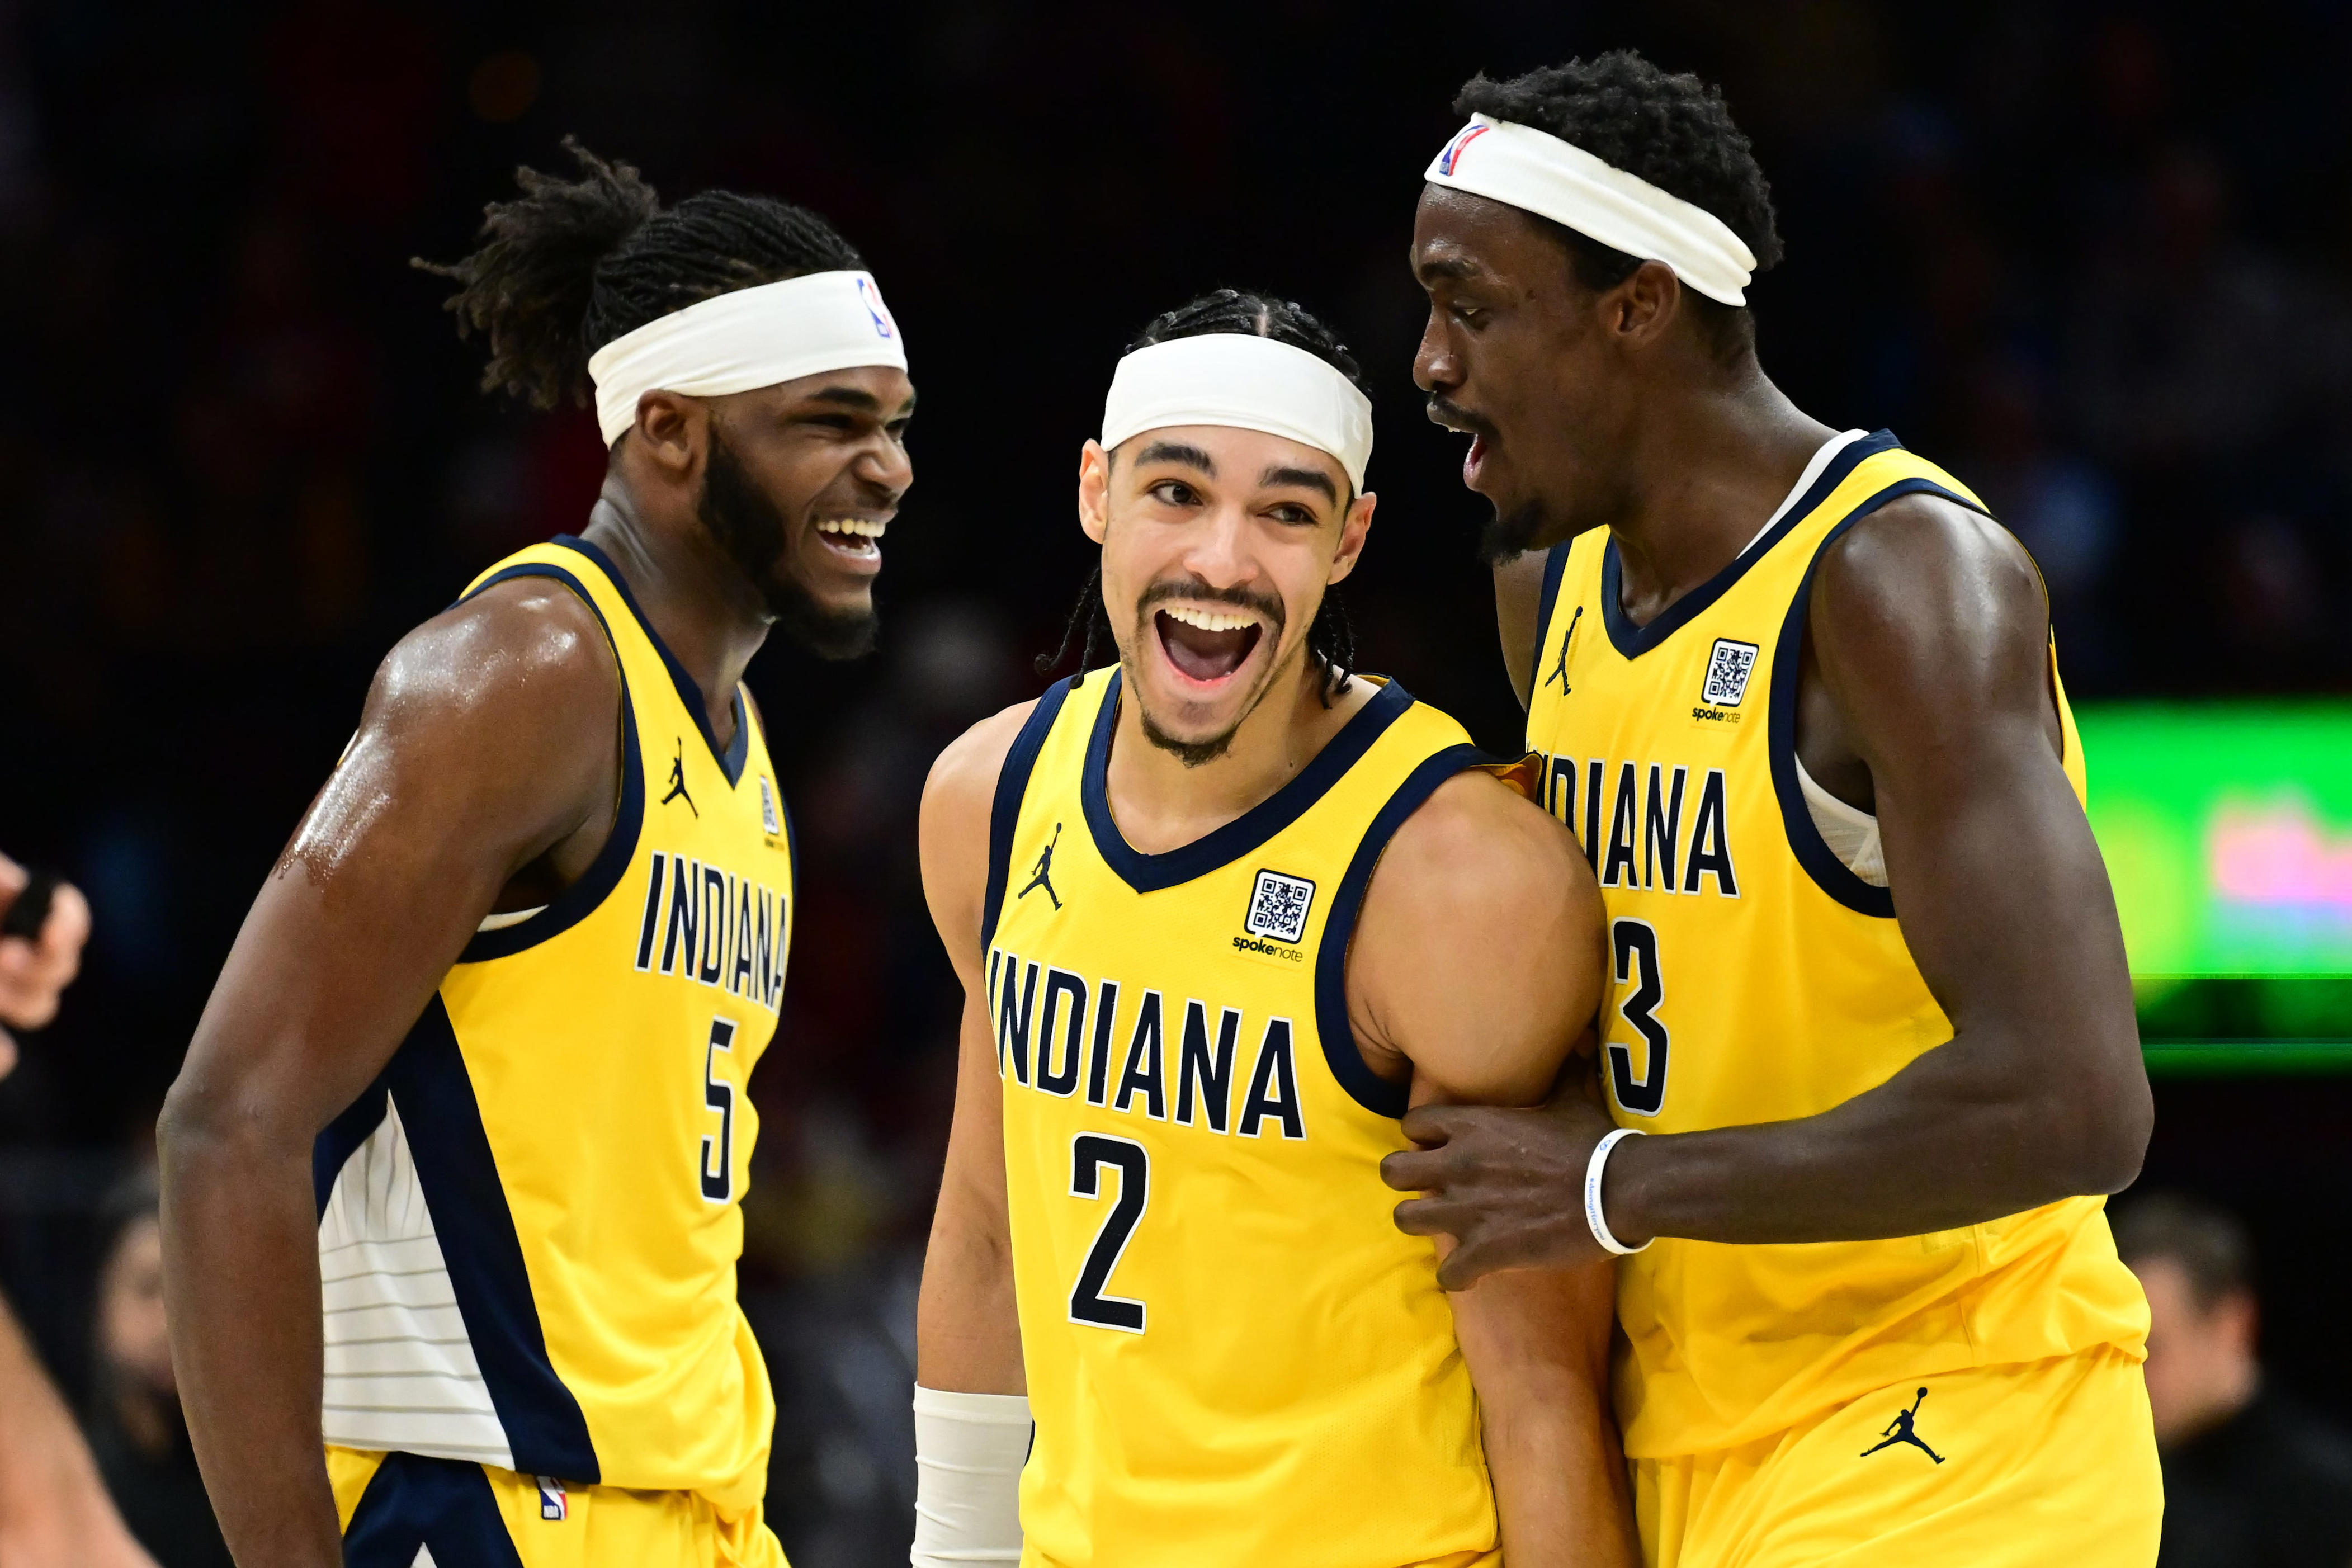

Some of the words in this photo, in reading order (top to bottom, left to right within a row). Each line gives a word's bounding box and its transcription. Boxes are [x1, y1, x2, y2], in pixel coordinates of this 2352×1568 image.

[1692, 707, 1740, 724] spokenote
[1526, 738, 1740, 899] DIANA
[634, 849, 787, 1017] INDIANA
[1232, 937, 1303, 962] spokenote
[1599, 916, 1670, 1117] 3
[699, 1014, 739, 1205] 5
[986, 945, 1307, 1141] INDIANA
[1068, 1130, 1151, 1335] 2
